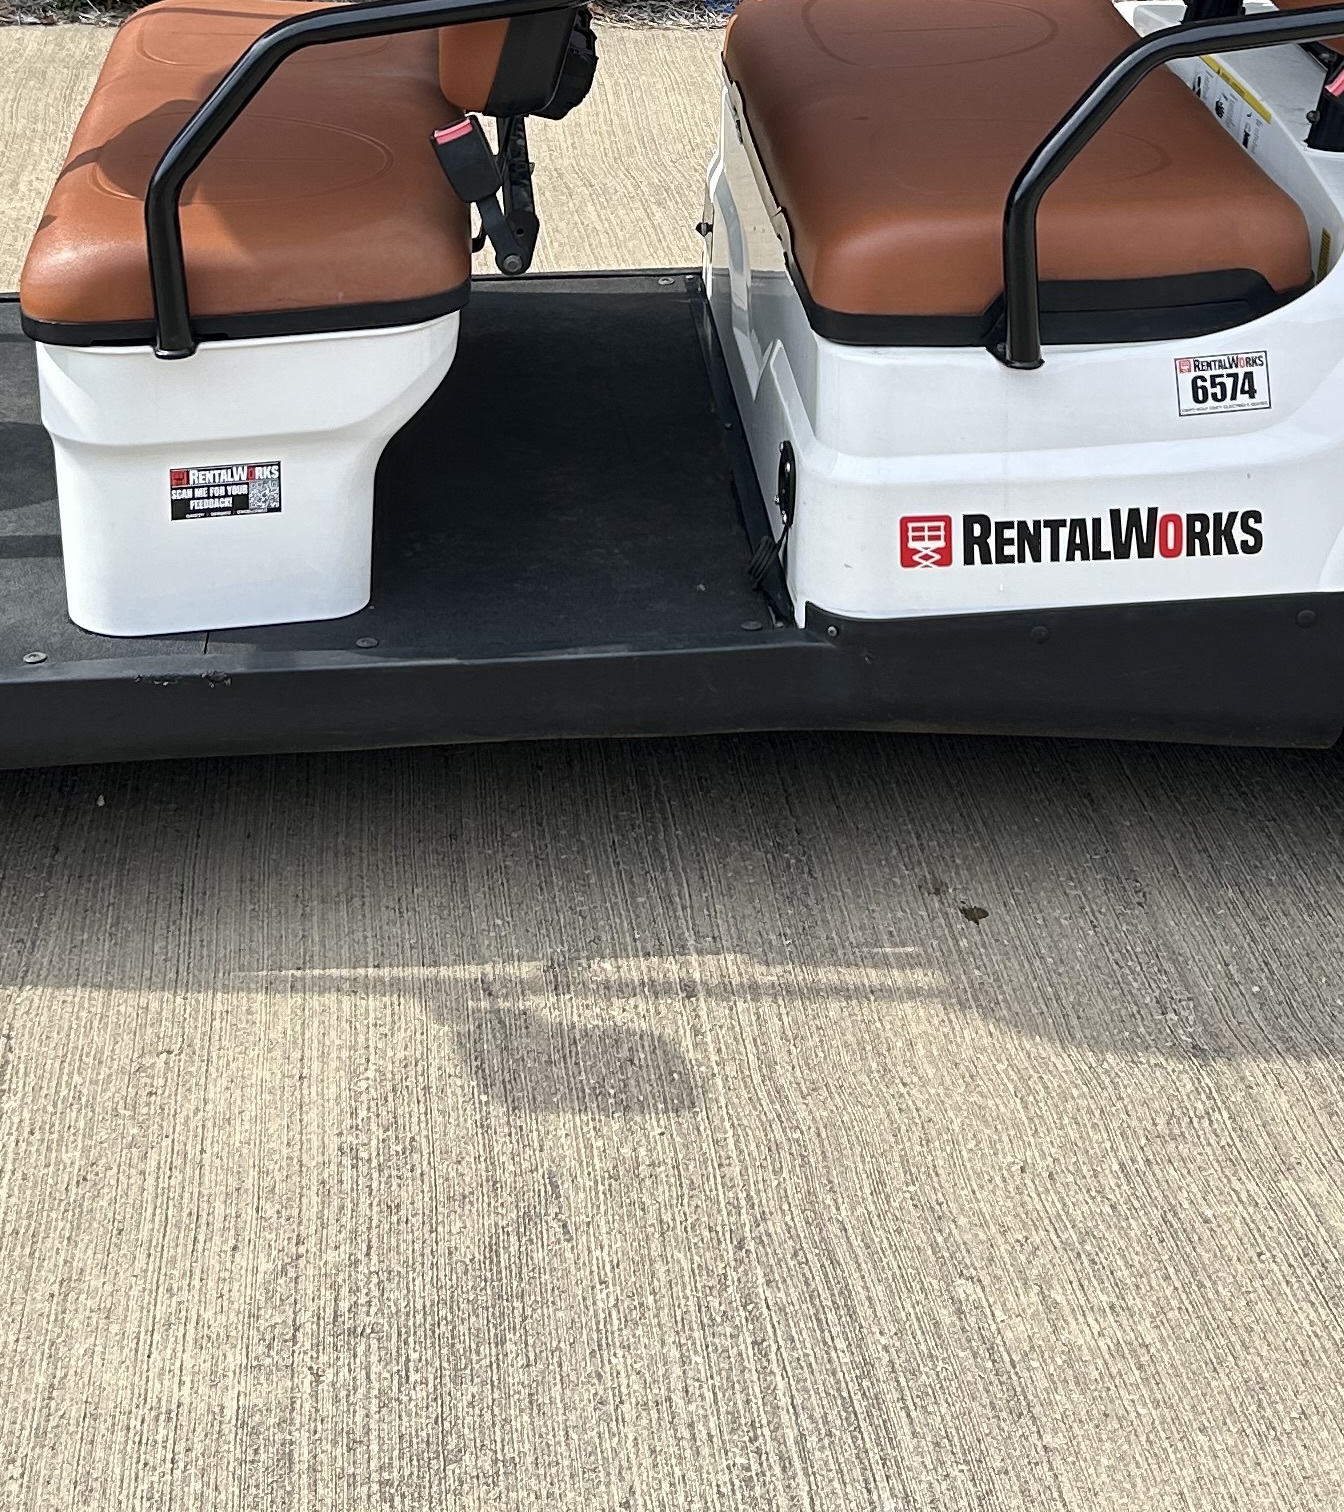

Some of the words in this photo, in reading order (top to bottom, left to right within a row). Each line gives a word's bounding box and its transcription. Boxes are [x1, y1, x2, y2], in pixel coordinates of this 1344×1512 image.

[1191, 370, 1257, 405] 6574
[171, 488, 193, 500] SCAN
[194, 487, 208, 498] ME
[209, 485, 226, 497] FOR
[227, 484, 248, 496] YOUR
[962, 506, 1264, 567] RENTALWORKS
